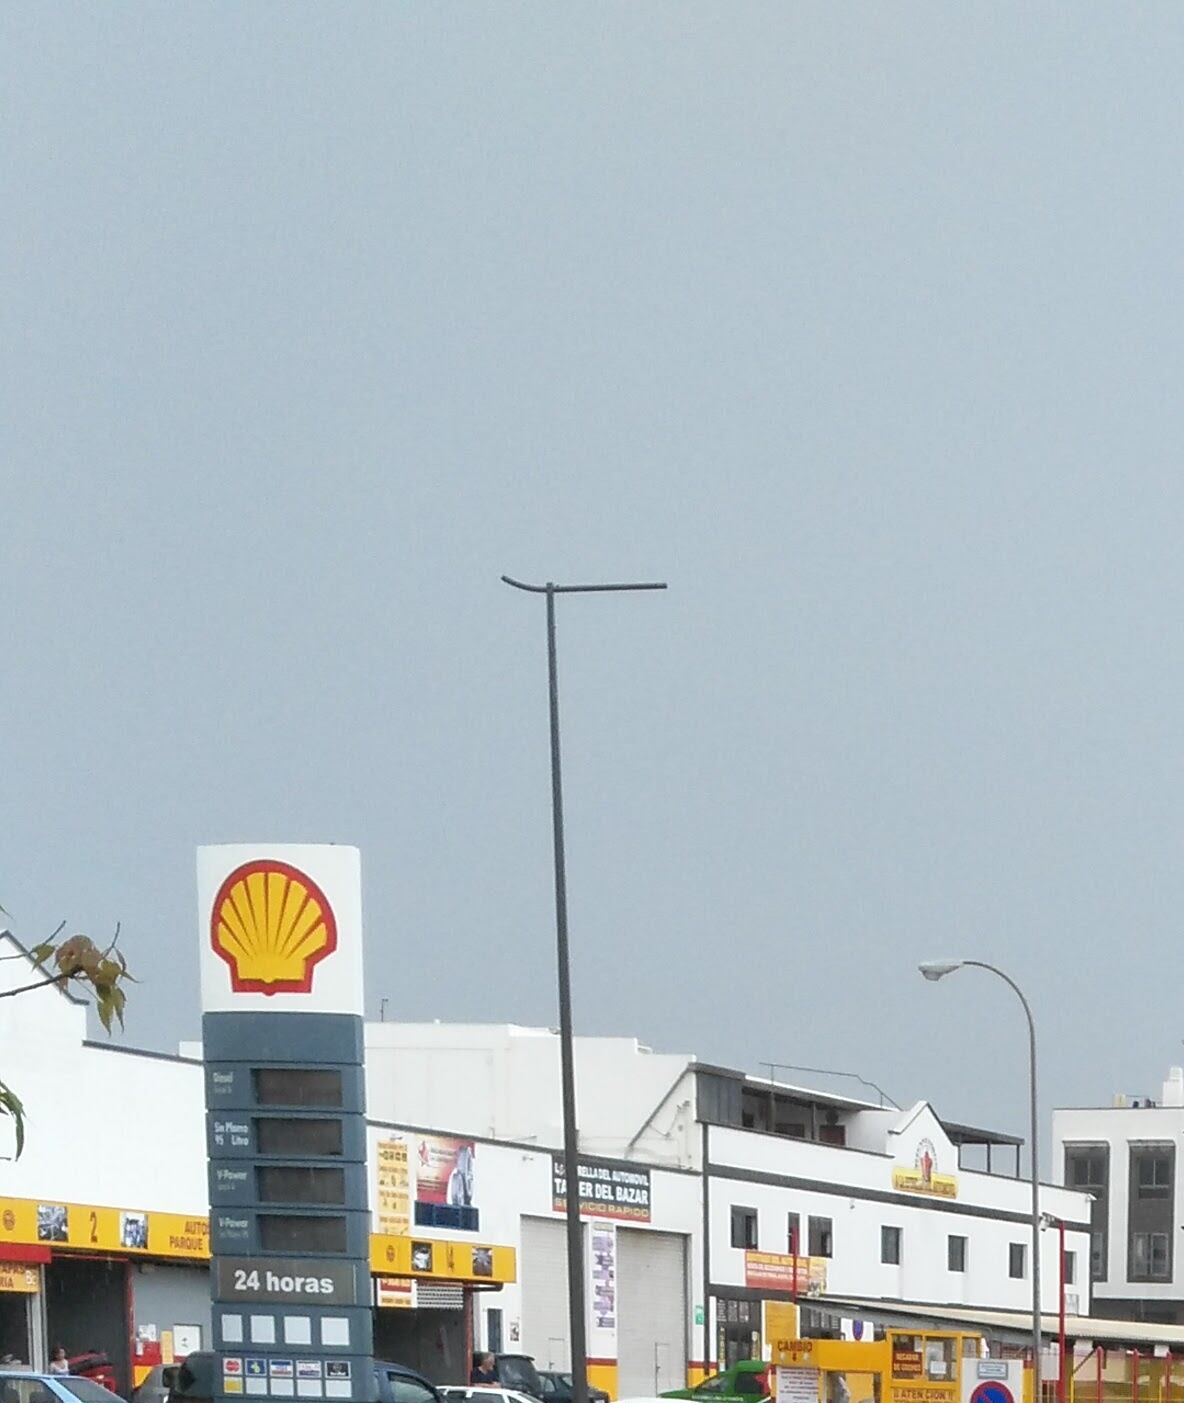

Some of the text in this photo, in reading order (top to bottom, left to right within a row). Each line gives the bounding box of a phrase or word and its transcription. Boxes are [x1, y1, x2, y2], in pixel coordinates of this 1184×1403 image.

[555, 1178, 649, 1206] TAER DEL BAZAR
[90, 1212, 98, 1243] 2
[234, 1269, 334, 1294] 24 horas
[778, 1341, 813, 1353] CAMBIO
